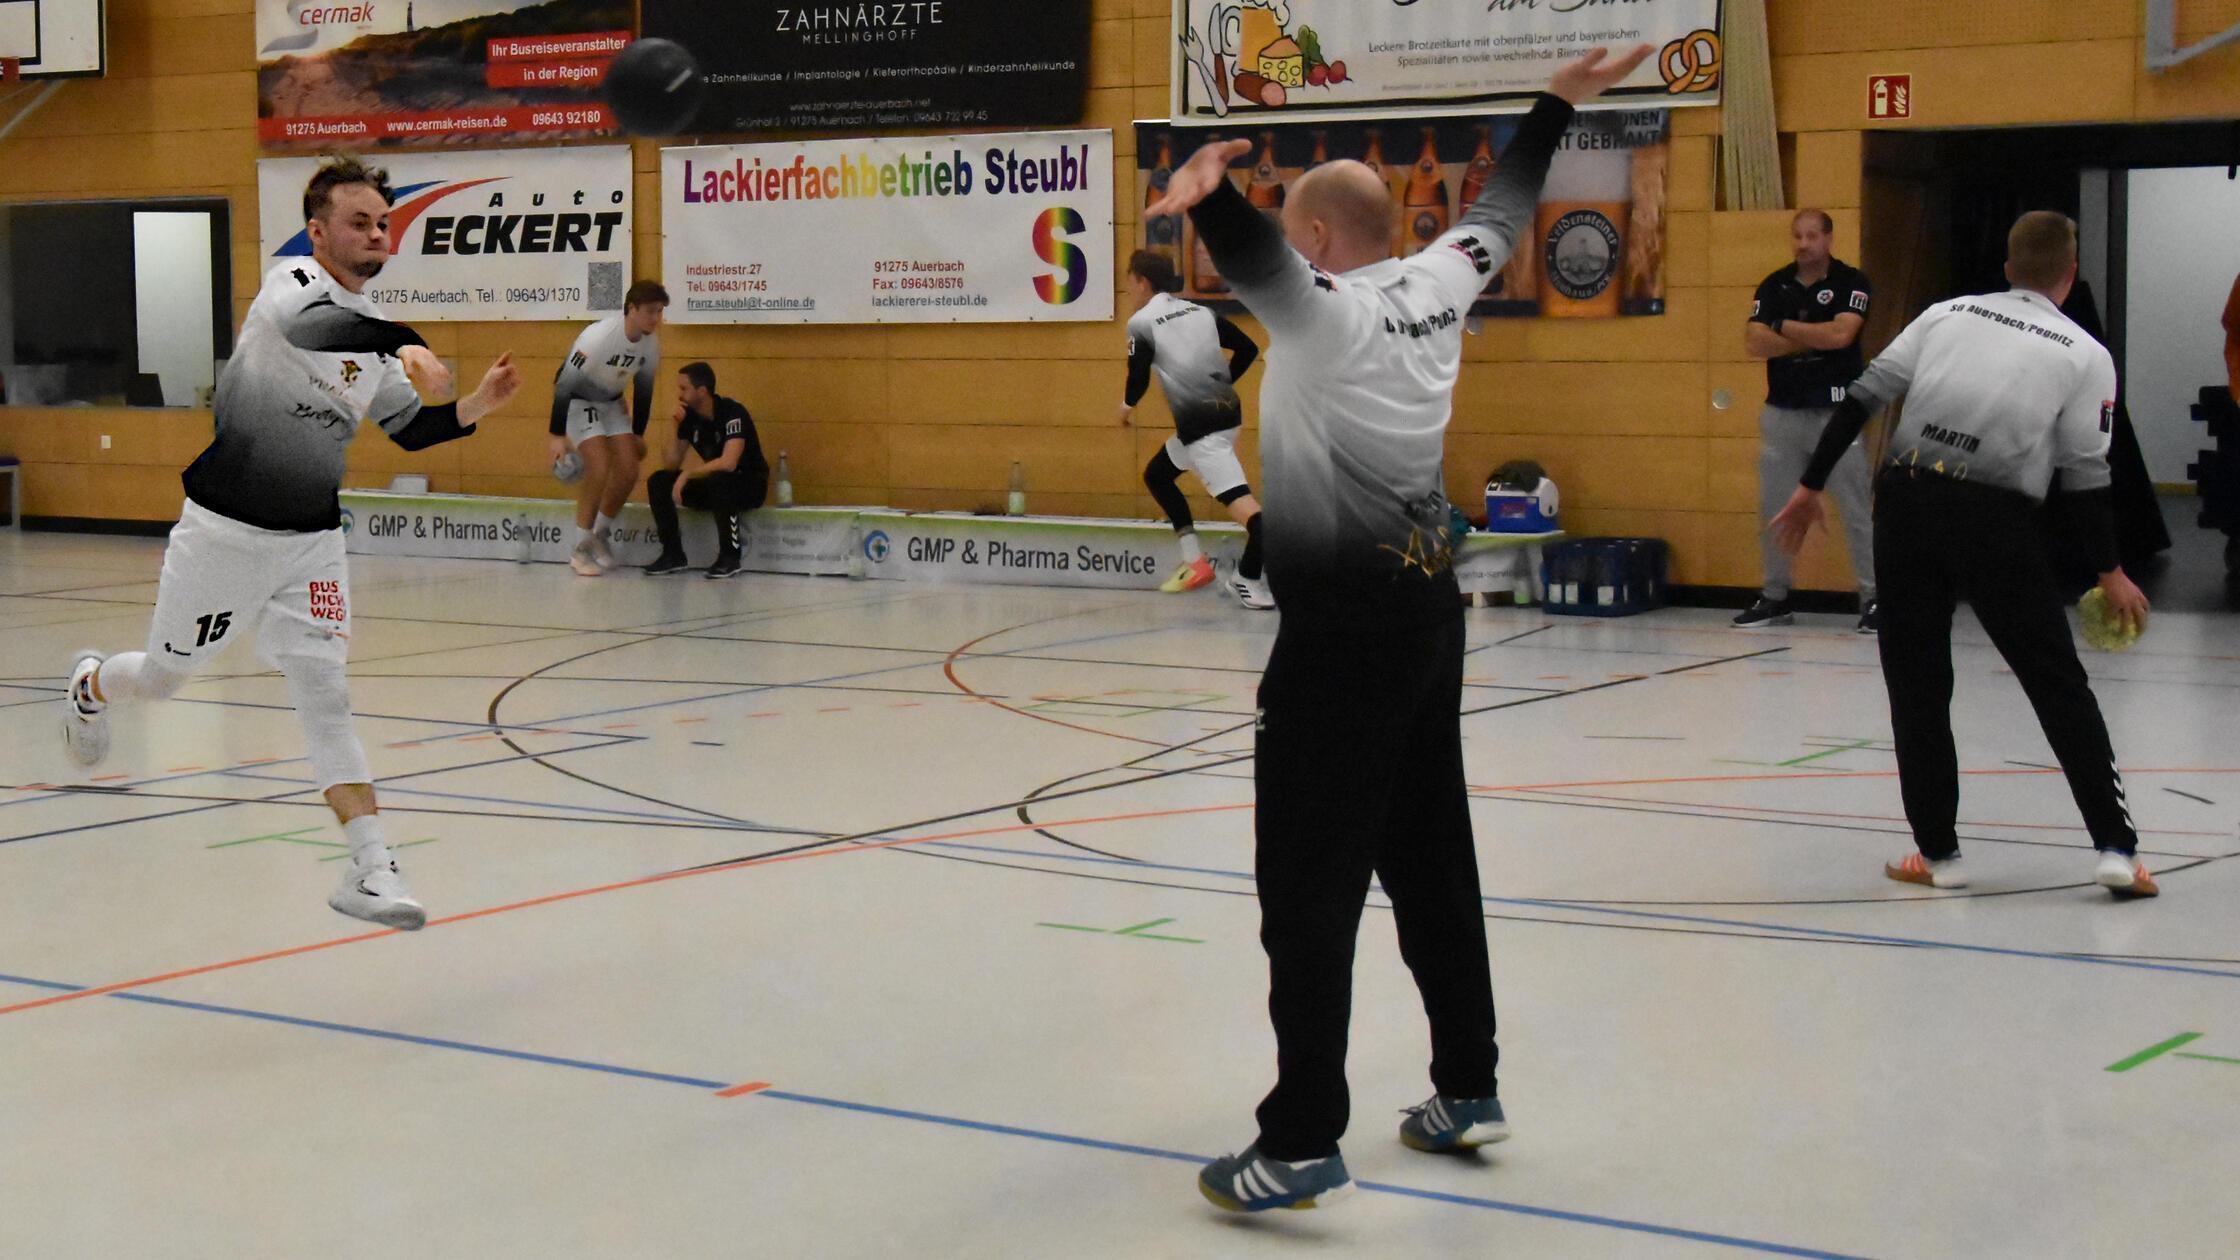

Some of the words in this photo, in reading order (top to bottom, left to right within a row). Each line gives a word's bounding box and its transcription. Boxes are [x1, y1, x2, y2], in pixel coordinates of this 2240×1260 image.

[301, 1, 375, 25] cermak
[776, 1, 944, 31] ZAHNÄRZTE
[492, 44, 507, 56] Ihr
[510, 37, 626, 56] Busreiseveranstalter
[802, 29, 918, 45] MELLINGHOFF
[1408, 38, 1471, 51] Brotzeitkarte
[1473, 37, 1490, 47] mit
[1556, 32, 1575, 43] und
[1579, 28, 1640, 43] bayerischen
[1462, 52, 1490, 64] sowie
[523, 68, 534, 80] in
[538, 66, 556, 80] der
[559, 64, 598, 80] Region
[711, 72, 782, 83] Zahnheilkunde
[794, 70, 860, 81] Implantologie
[286, 123, 316, 135] 91275
[317, 121, 367, 134] Auerbach
[387, 115, 507, 131] www.cermak-reisen.de
[532, 112, 564, 125] 09643
[567, 110, 600, 124] 92180
[683, 149, 973, 204] Lackierfachbetrieb
[984, 144, 1089, 195] Steubl
[489, 190, 623, 208] Auto
[421, 211, 624, 256] ECKERT
[1031, 207, 1088, 305] S
[874, 260, 909, 272] 91275
[911, 260, 965, 272] Auerbach
[708, 280, 767, 293] 09643/1745
[872, 278, 898, 290] Fax:
[900, 276, 964, 290] 09643/8576
[371, 290, 408, 304] 91275
[506, 287, 580, 303] 09643/1370
[872, 294, 988, 308] lackiererei-steubl.de
[1920, 422, 1981, 454] MARTIN
[368, 515, 408, 538] GMP
[413, 517, 427, 539] &
[433, 517, 498, 541] Pharma
[502, 518, 562, 545] Sevice
[907, 535, 955, 564] GMP
[961, 541, 979, 565] &
[988, 543, 1069, 571] Pharma
[1078, 545, 1156, 575] Service
[309, 580, 339, 593] BUS
[196, 611, 233, 647] 15
